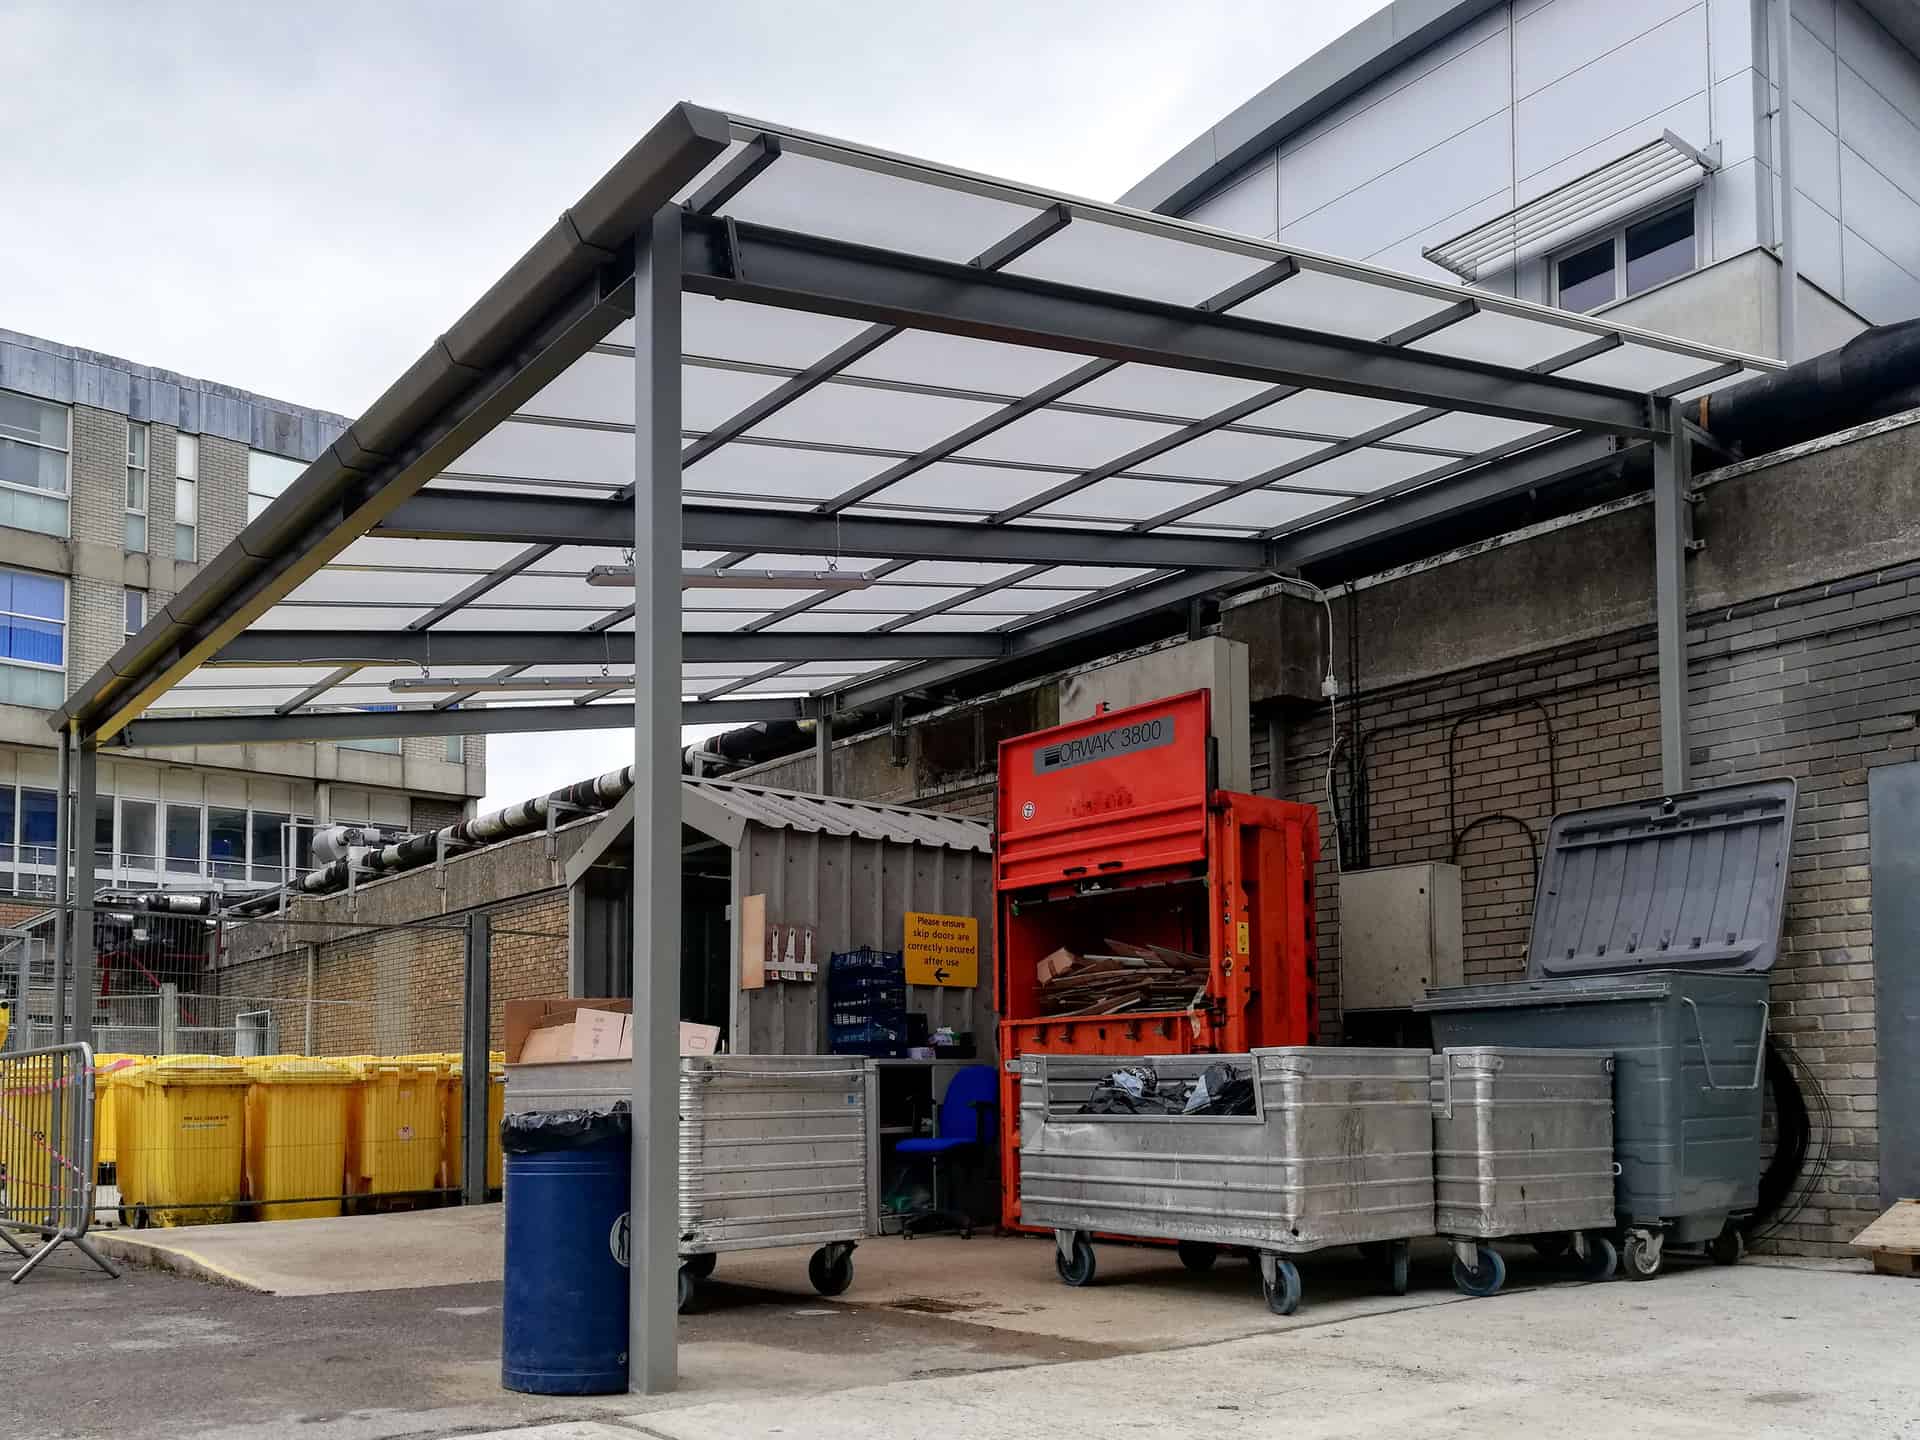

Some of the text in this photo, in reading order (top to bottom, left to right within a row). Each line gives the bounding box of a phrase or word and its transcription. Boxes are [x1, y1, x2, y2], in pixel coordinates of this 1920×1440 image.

[1060, 732, 1115, 762] ORWAK
[1120, 720, 1161, 747] 3800
[917, 916, 966, 928] Please ensure
[913, 928, 929, 940] skip
[932, 930, 954, 941] doors
[907, 943, 976, 954] correctly secured
[923, 957, 960, 967] after use
